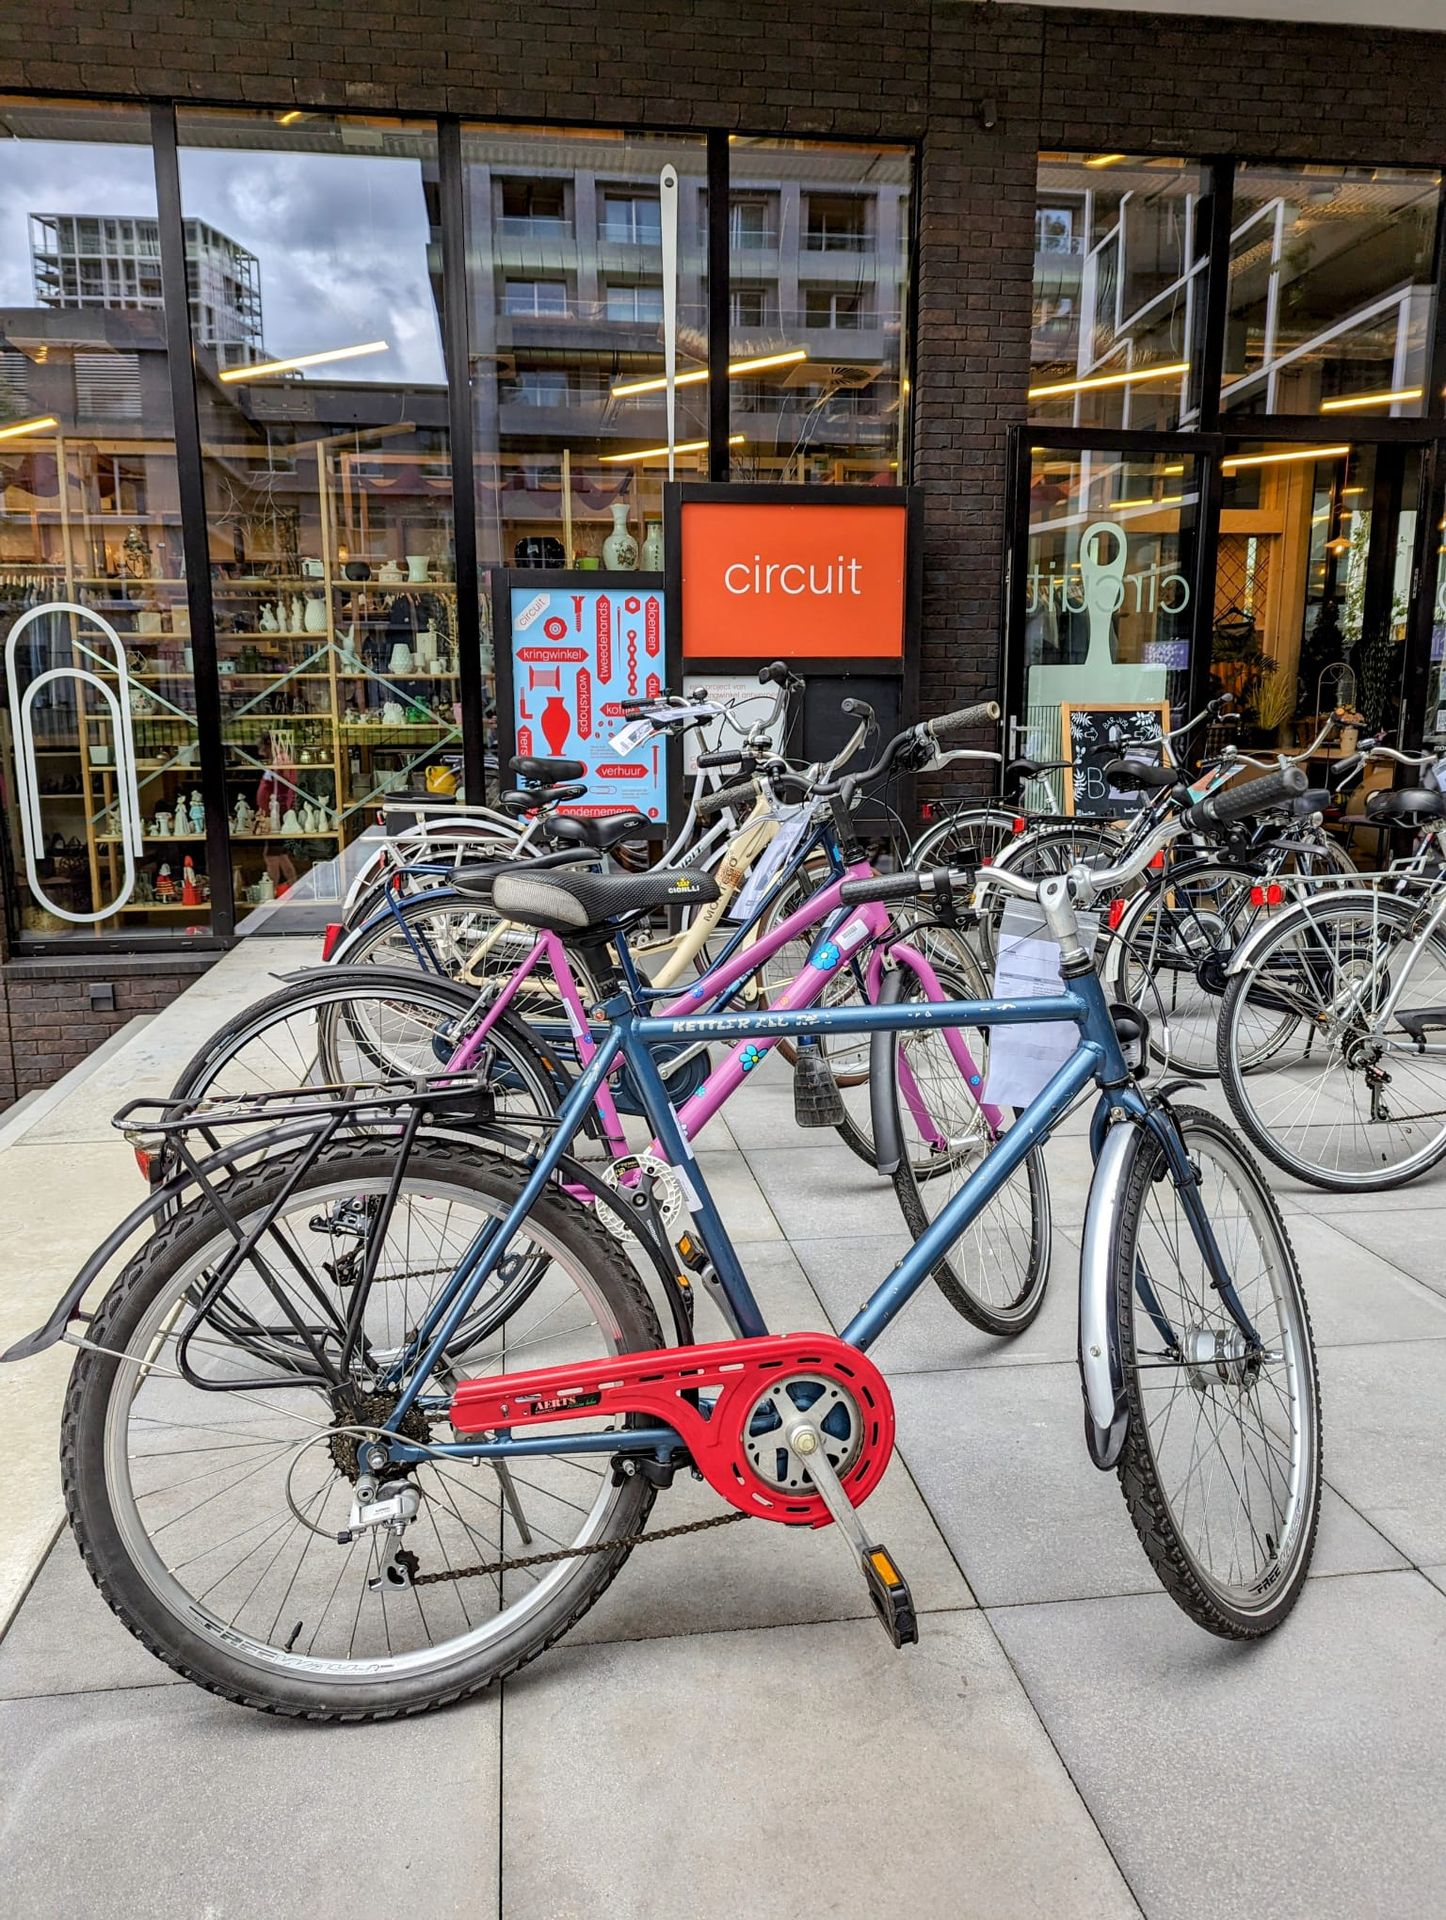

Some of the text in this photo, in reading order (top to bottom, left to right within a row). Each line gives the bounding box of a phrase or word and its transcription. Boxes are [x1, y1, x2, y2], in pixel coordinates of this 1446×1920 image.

[723, 554, 864, 596] circuit
[518, 596, 548, 628] circuit
[647, 601, 658, 651] bloemen
[523, 647, 582, 662] kringwinkel
[598, 601, 610, 678] tweedehonds
[579, 674, 590, 734] workshops
[601, 765, 642, 777] verhuur
[703, 857, 738, 922] MOTEGO
[672, 1017, 752, 1033] KETTLER
[534, 1396, 577, 1412] AERTS
